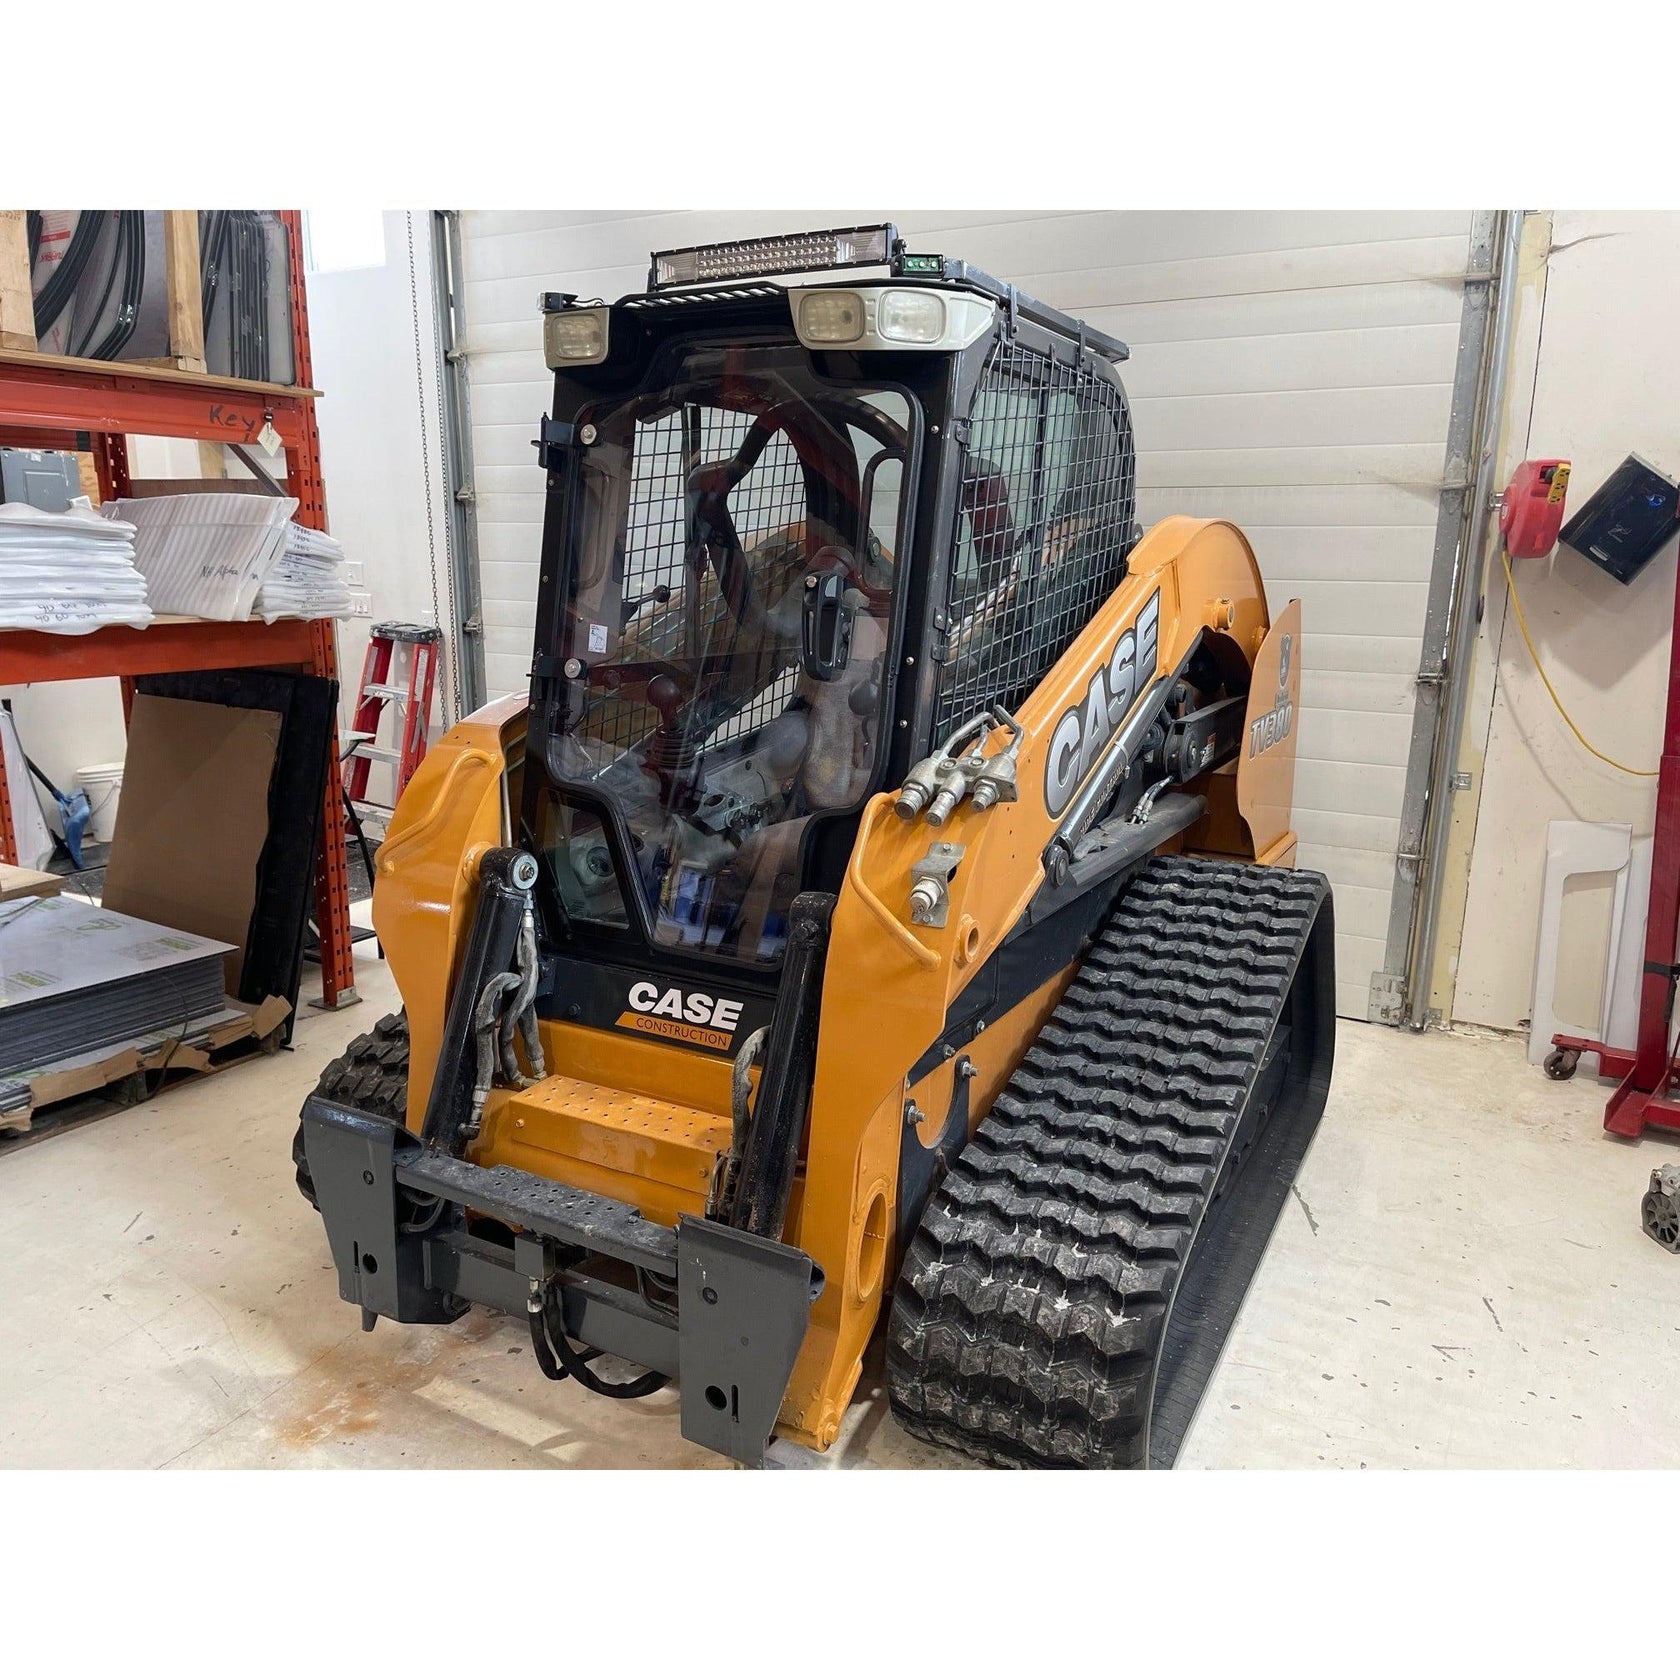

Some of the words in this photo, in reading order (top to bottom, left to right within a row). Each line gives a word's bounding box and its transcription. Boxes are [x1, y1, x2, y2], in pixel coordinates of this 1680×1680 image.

[209, 403, 256, 442] Key
[1045, 590, 1159, 816] CASE
[628, 981, 744, 1031] CASE
[636, 1017, 728, 1047] CONSTRUCTION
